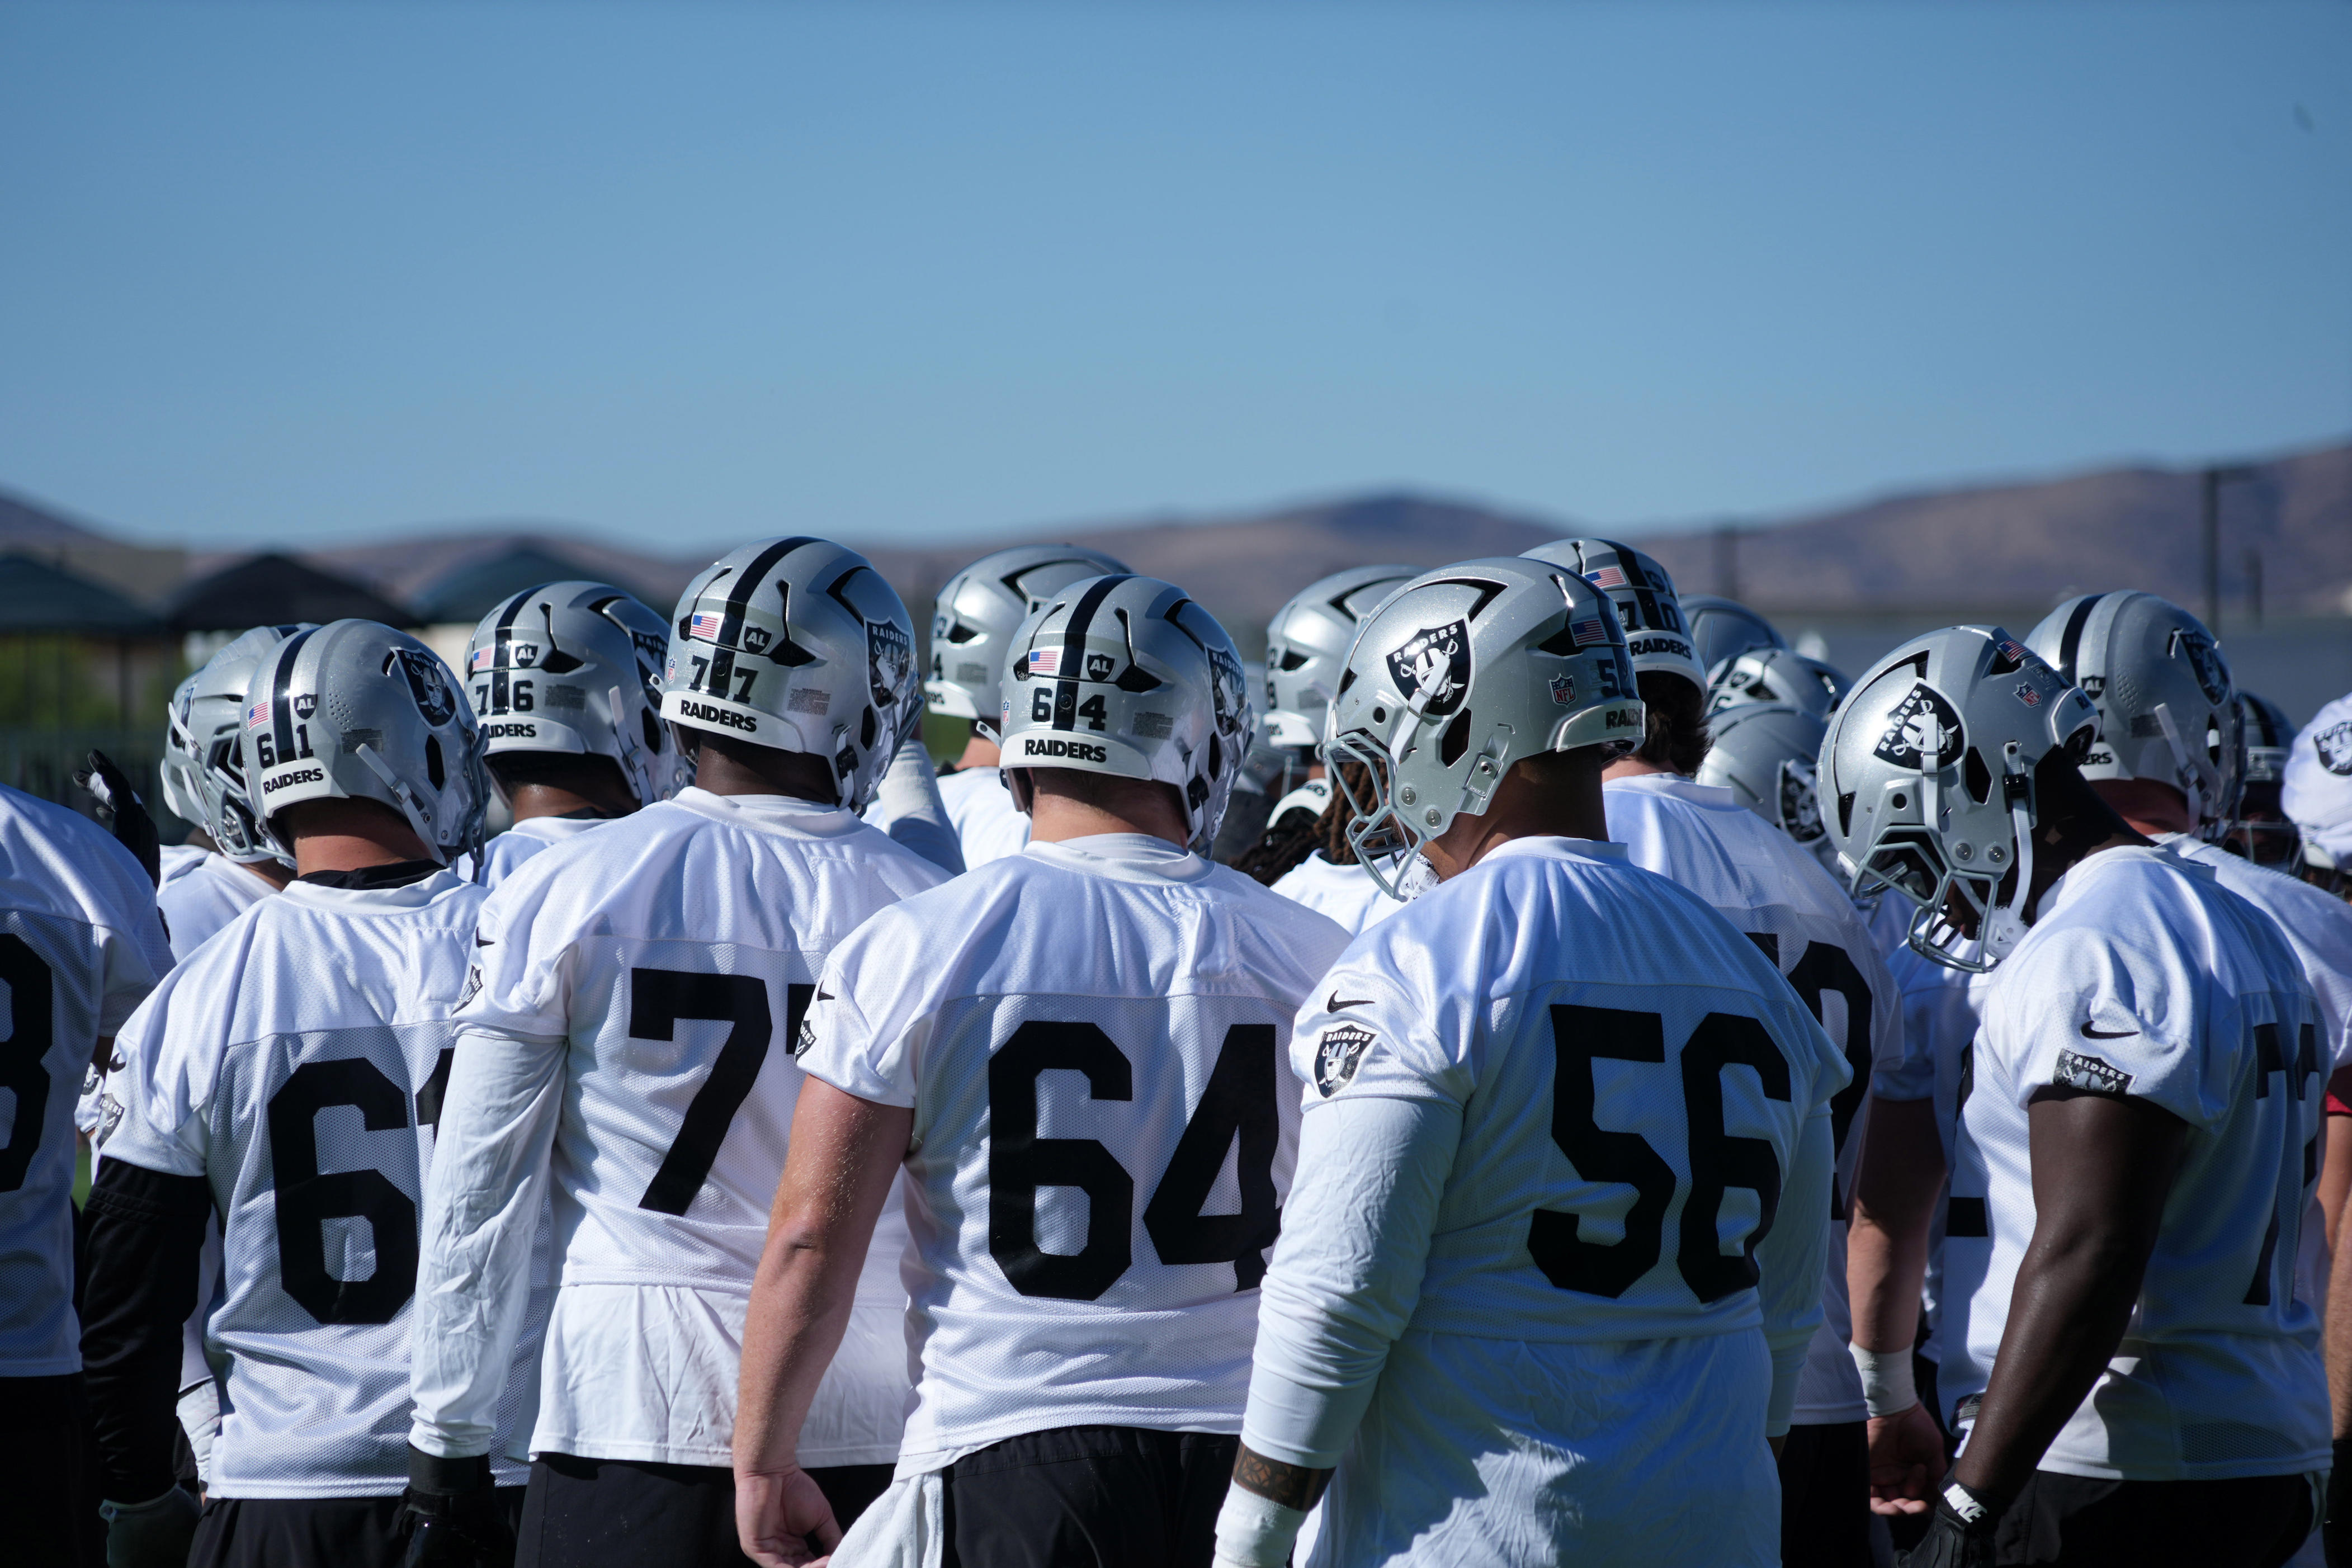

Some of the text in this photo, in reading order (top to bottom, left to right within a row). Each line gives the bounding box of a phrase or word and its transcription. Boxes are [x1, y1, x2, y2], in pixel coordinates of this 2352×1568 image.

[746, 631, 766, 647] AL
[872, 625, 908, 645] RAIDERS
[517, 648, 535, 660] AL
[1628, 637, 1692, 660] RAIDERS
[1089, 659, 1110, 673] AL
[1555, 687, 1575, 702] NFL
[2085, 679, 2103, 691] AL
[296, 698, 315, 711] AL
[680, 699, 757, 733] RAIDERS
[1878, 689, 1923, 752] RAIDERS
[489, 724, 537, 738] IDERS
[1025, 739, 1107, 763] RAIDERS
[262, 768, 324, 795] RAIDERS
[1326, 1031, 1371, 1042] RAIDERS
[2065, 1052, 2125, 1080] RAIDERS
[99, 1098, 123, 1116] IDERS
[989, 1021, 1282, 1302] 64
[1527, 1004, 1792, 1304] 56
[1943, 1483, 1987, 1523] NIKE
